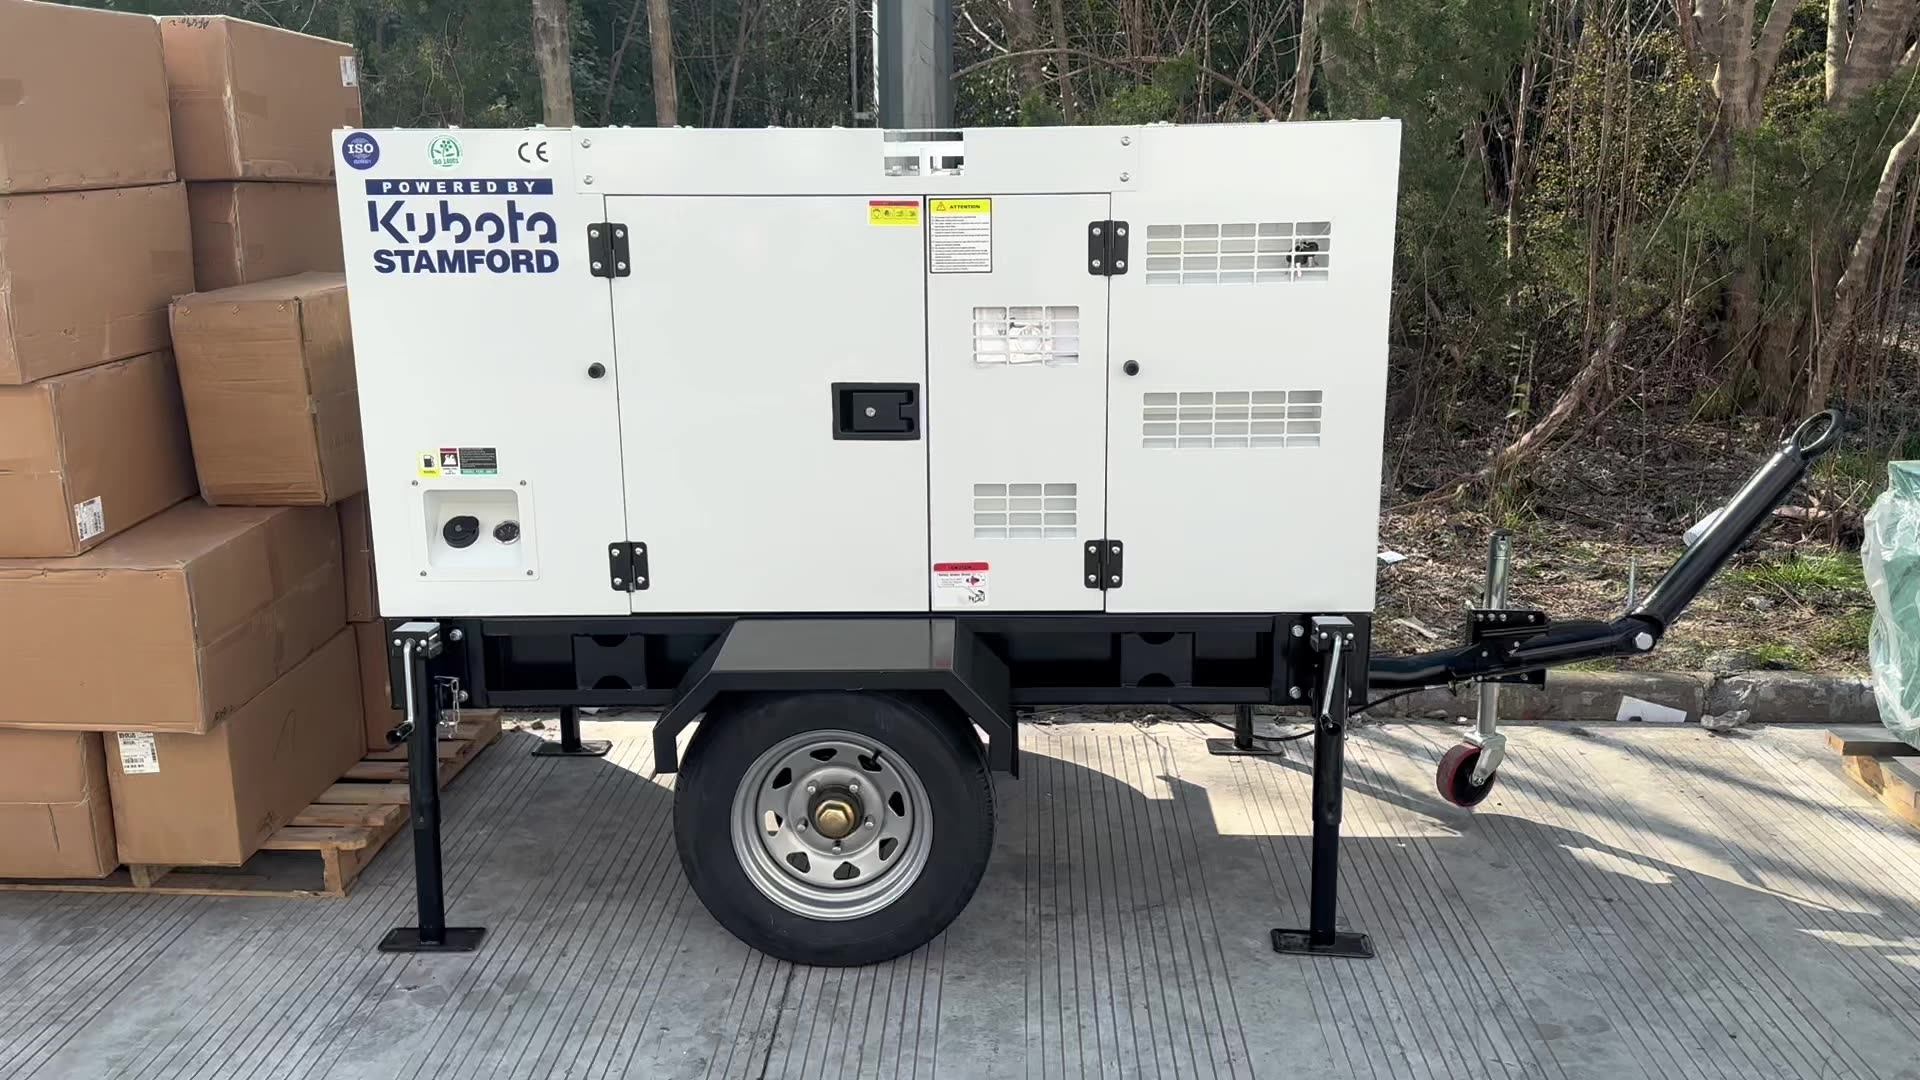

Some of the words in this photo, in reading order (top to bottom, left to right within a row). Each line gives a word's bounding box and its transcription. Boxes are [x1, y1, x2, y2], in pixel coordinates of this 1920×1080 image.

[347, 143, 374, 154] ISO
[517, 141, 549, 163] CE
[382, 181, 498, 193] POWERED
[507, 180, 536, 193] BY
[367, 199, 558, 244] Kubota
[373, 249, 560, 274] STAMFORD
